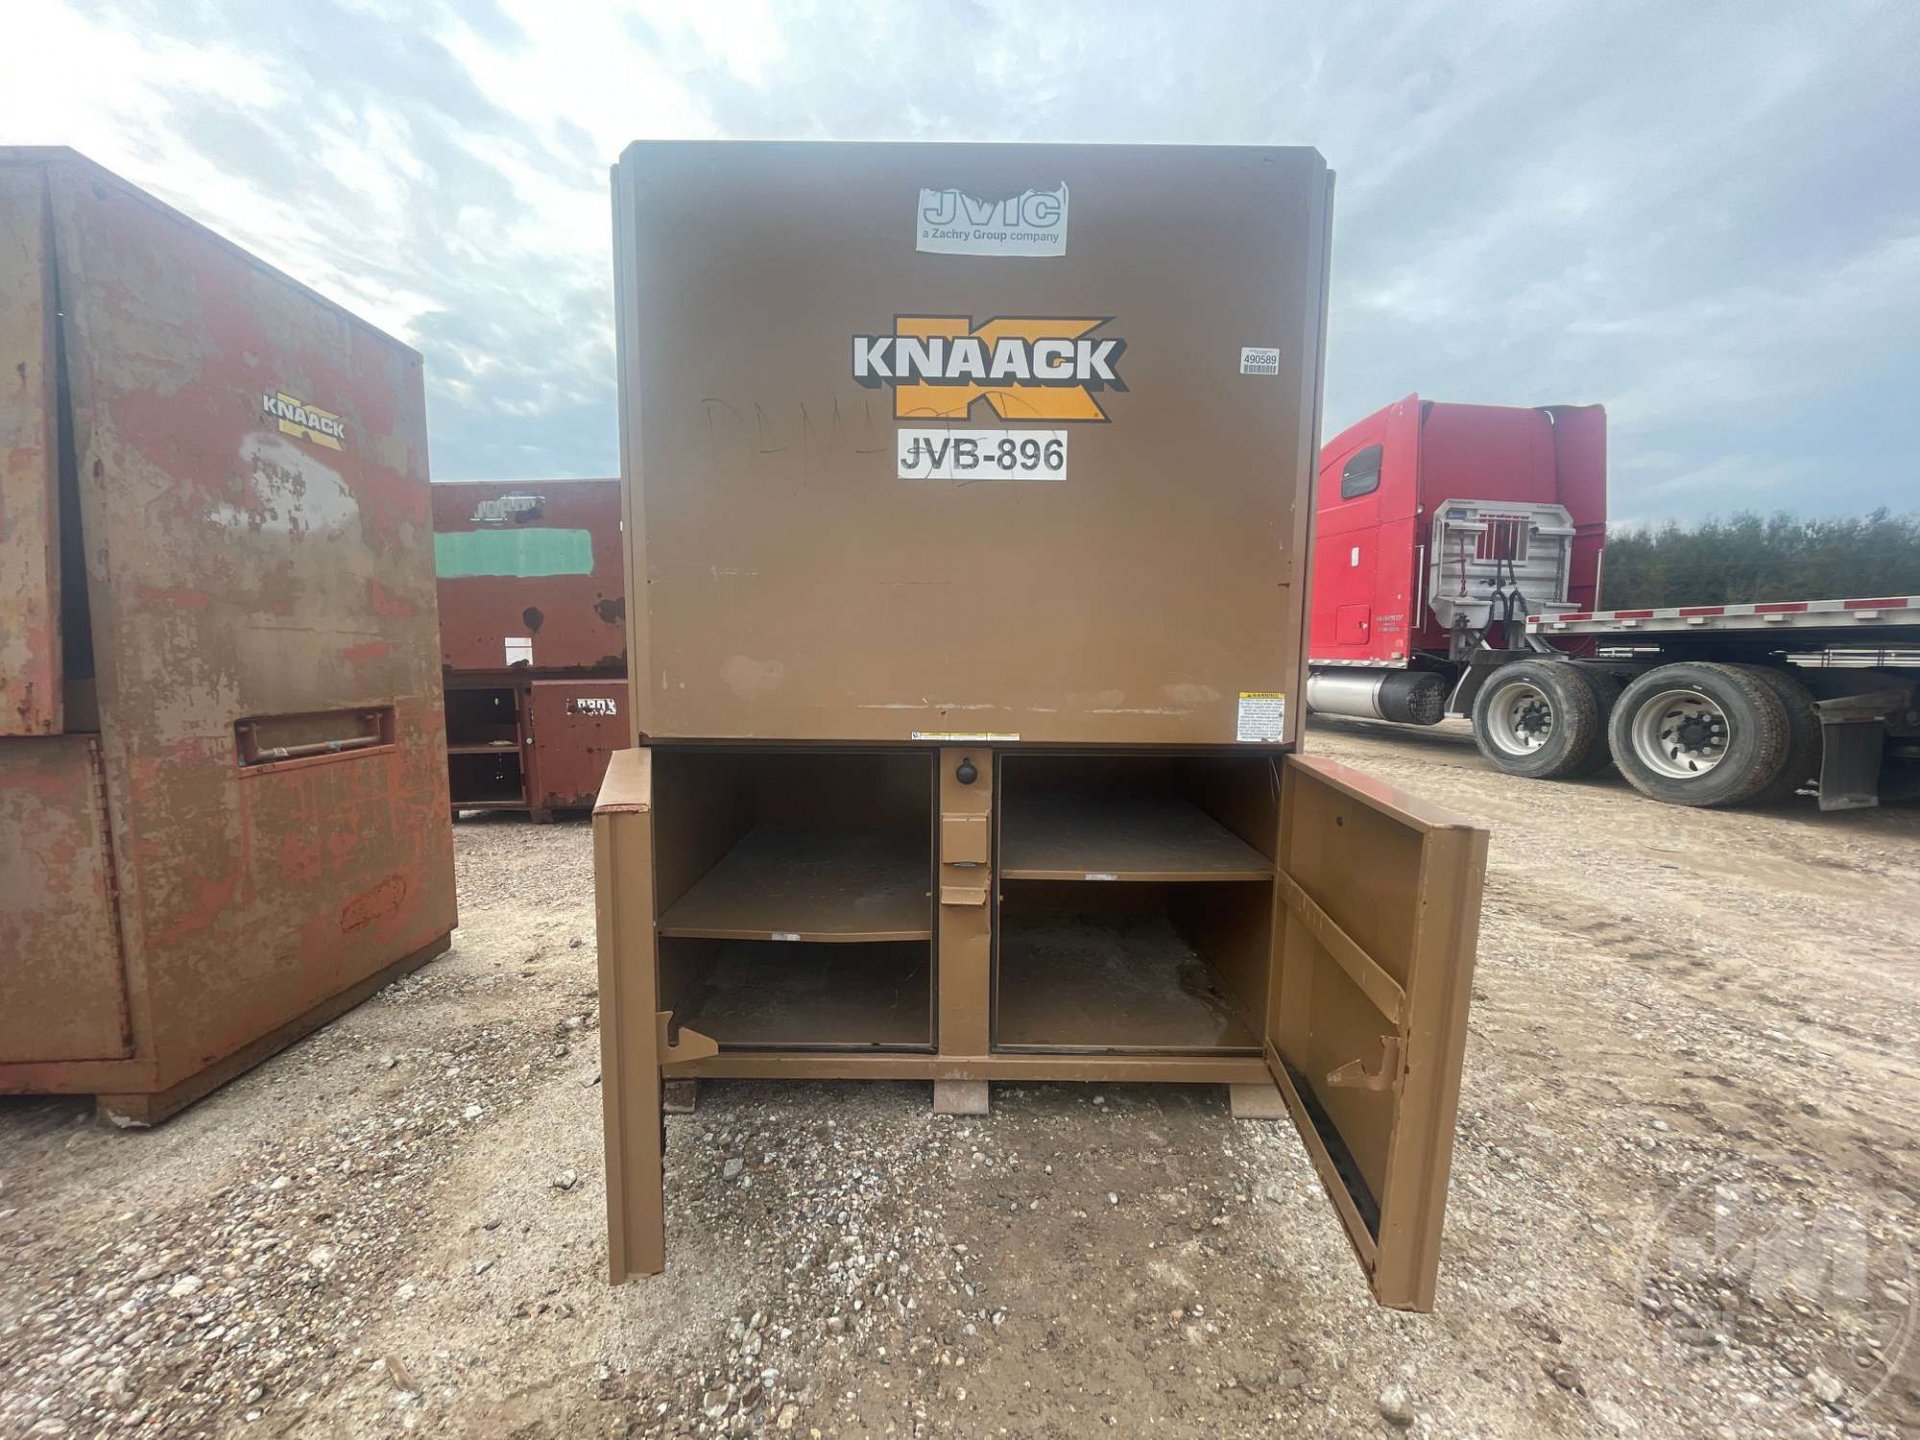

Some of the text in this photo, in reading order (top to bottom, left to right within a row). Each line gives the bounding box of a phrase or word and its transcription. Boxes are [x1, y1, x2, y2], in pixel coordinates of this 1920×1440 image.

[923, 191, 1061, 228] JVIC
[922, 228, 1059, 244] a Zachry Group company
[853, 336, 1118, 381] KNAACK
[1244, 354, 1277, 365] 490589
[262, 394, 345, 439] KNAACK
[900, 436, 1065, 472] JVB-896
